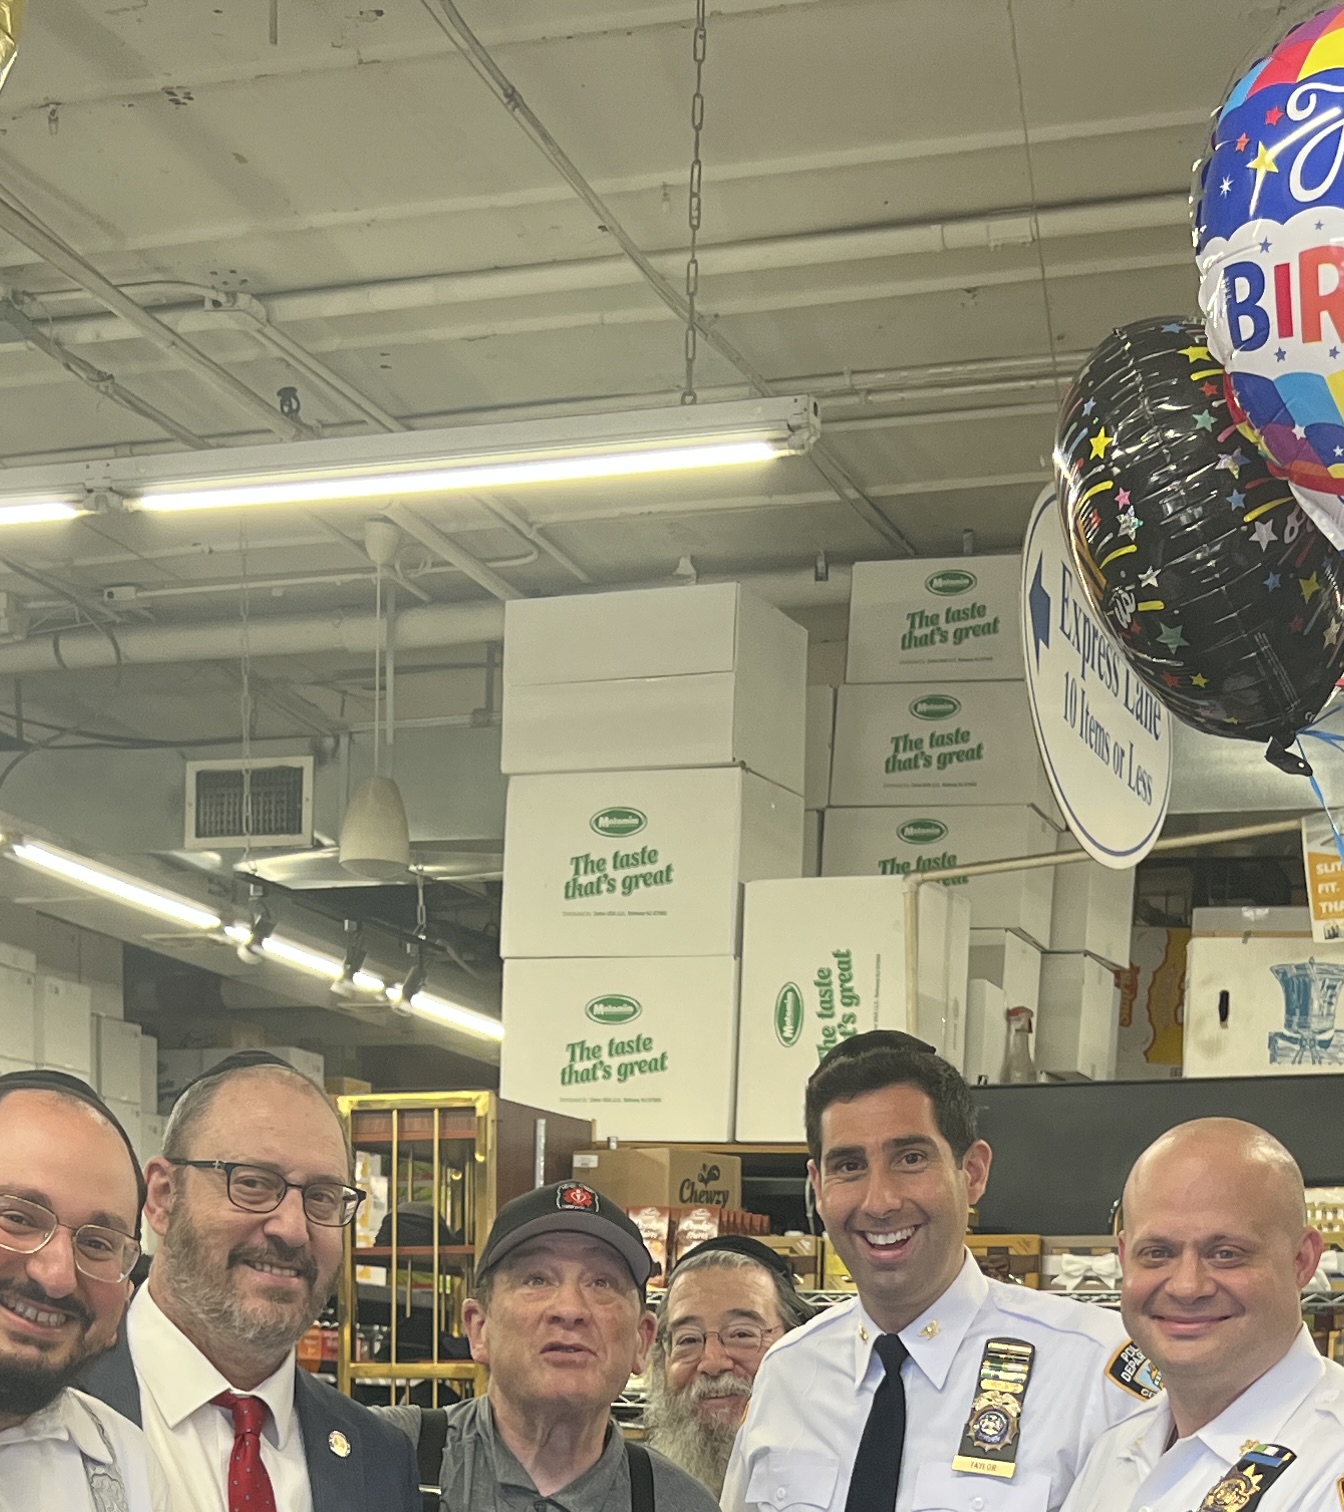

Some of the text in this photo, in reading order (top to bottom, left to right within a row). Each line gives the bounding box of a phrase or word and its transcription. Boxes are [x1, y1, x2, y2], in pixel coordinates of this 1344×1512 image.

[906, 602, 986, 629] The taste
[901, 616, 1000, 651] that's great
[1059, 560, 1162, 741] Express Lane
[891, 727, 970, 754] The taste
[1063, 671, 1153, 807] 10 Items or Less
[885, 742, 984, 774] that's great
[570, 845, 659, 876] The taste
[878, 856, 911, 875] The
[564, 863, 674, 900] that's great
[813, 967, 835, 1019] taste
[832, 949, 860, 1007] great
[566, 1033, 653, 1063] The taste
[560, 1051, 668, 1087] that's great
[679, 1178, 729, 1209] Chewzy
